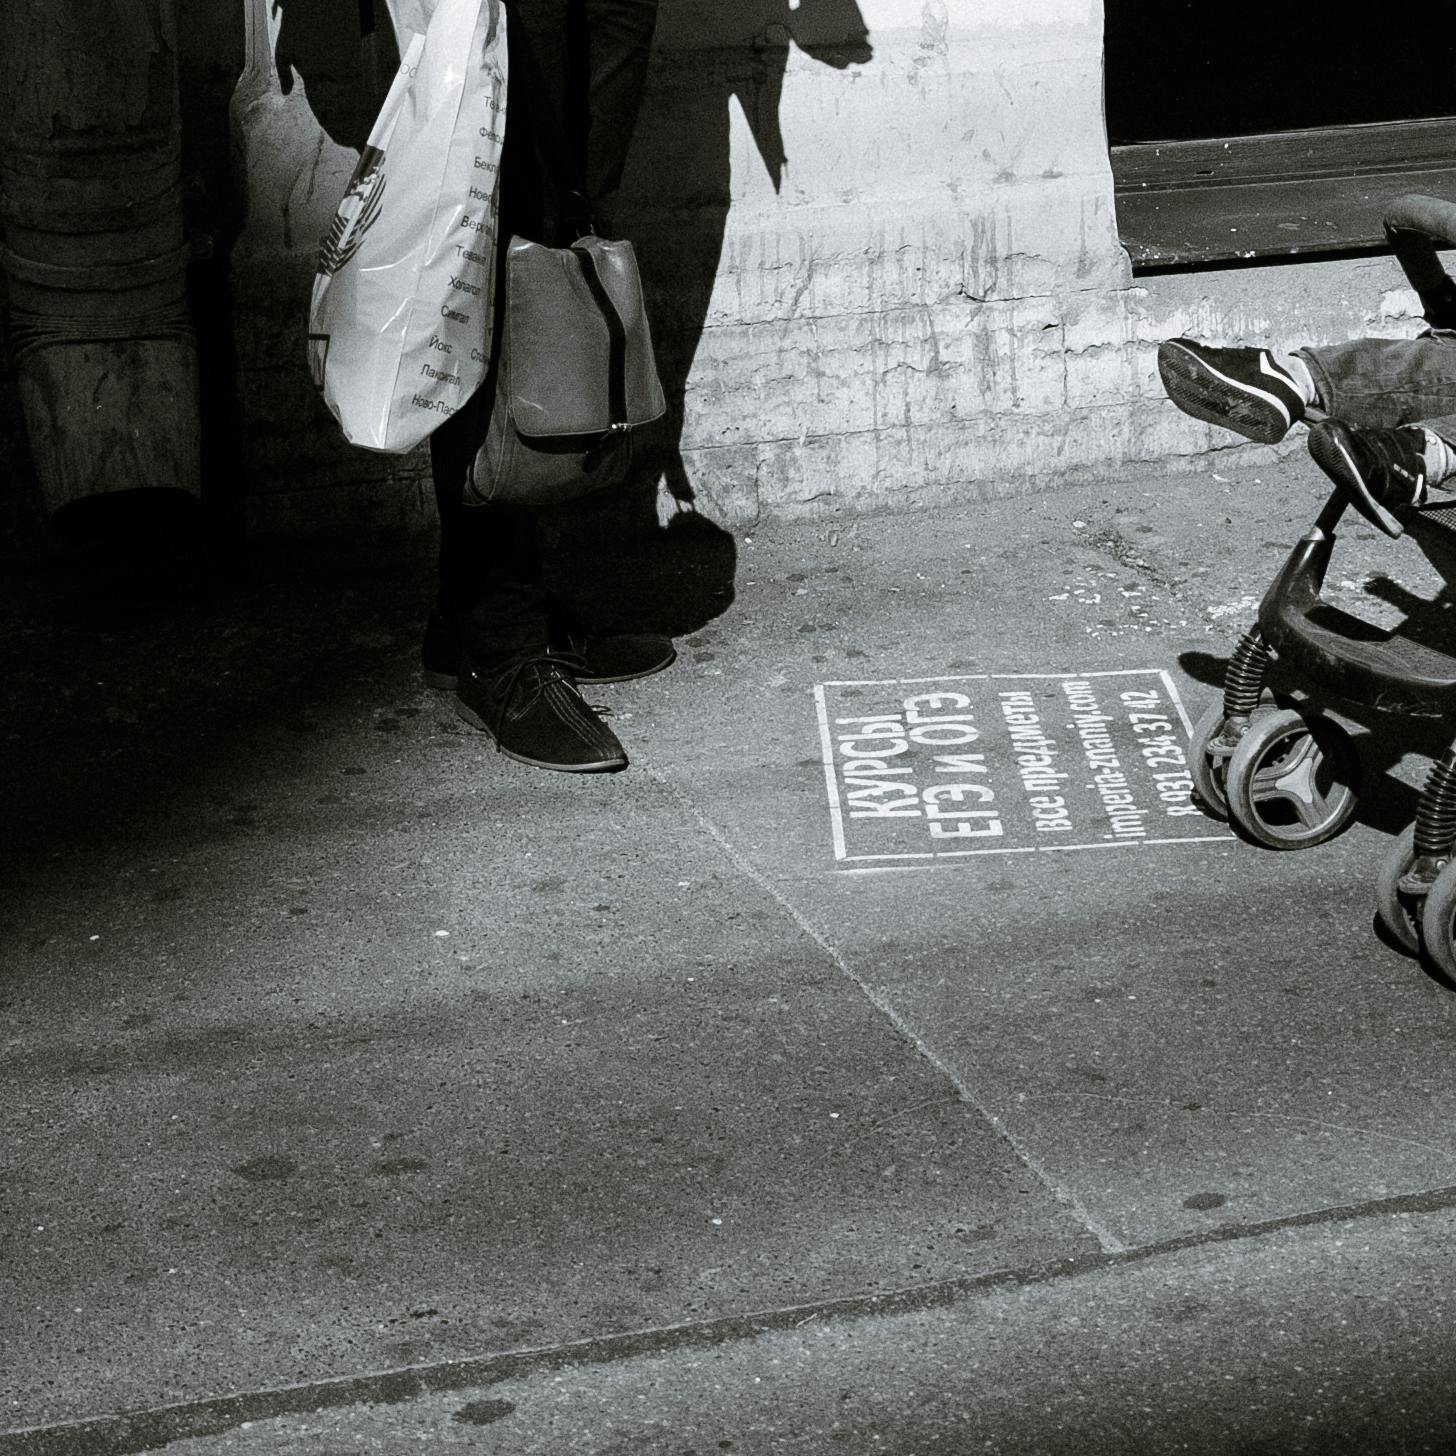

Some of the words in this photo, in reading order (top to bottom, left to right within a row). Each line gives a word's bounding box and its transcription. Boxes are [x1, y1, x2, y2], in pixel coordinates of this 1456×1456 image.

[1120, 689, 1161, 709] 42
[903, 692, 980, 746] ОГЭ
[1128, 713, 1173, 733] 37
[997, 691, 1070, 792] предметы
[1136, 734, 1187, 768] 234
[835, 713, 922, 819] КУРСЫ
[932, 753, 988, 774] и
[1062, 680, 1149, 839] imperia-znaniy.com
[1152, 769, 1195, 802] 931
[921, 783, 1004, 839] ЕГЭ
[1166, 804, 1204, 817] 8
